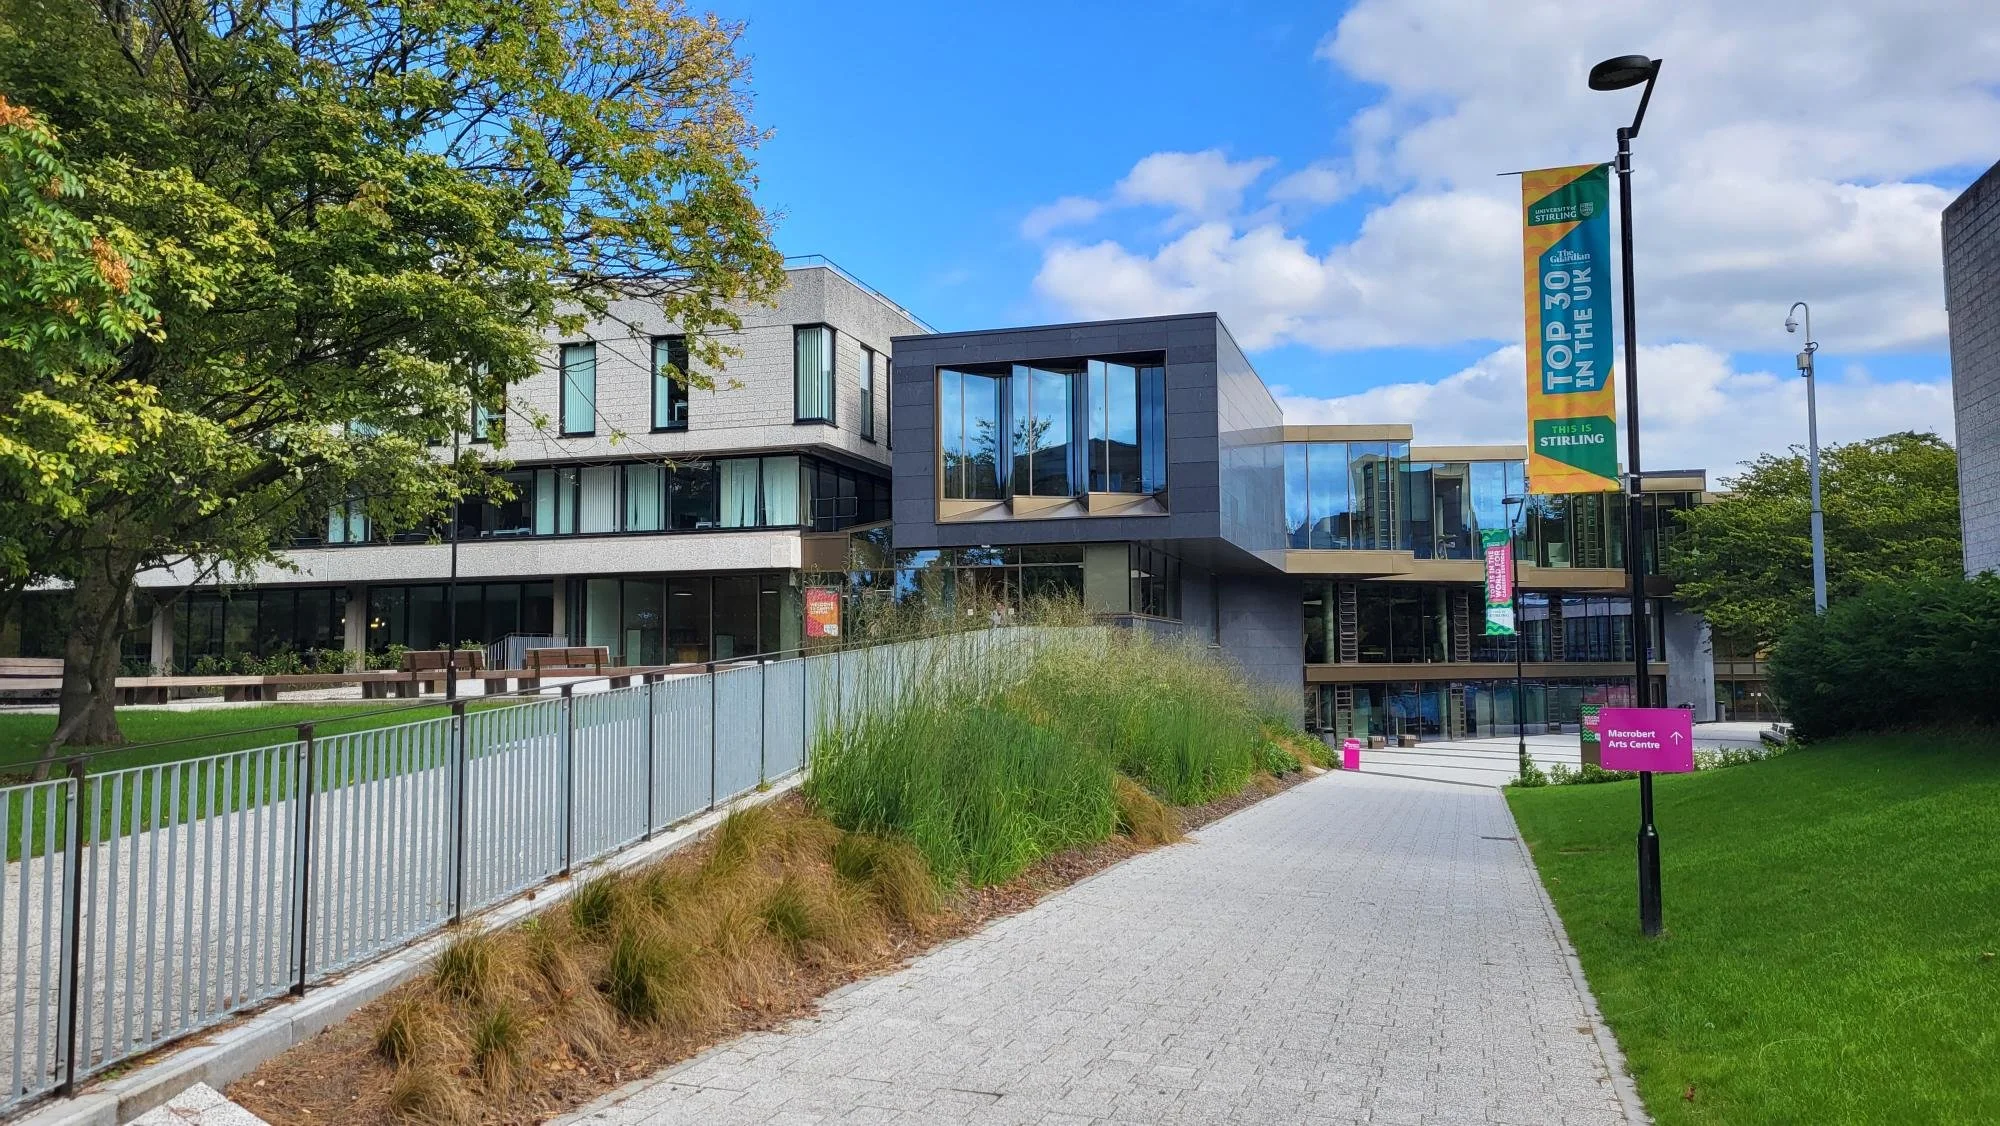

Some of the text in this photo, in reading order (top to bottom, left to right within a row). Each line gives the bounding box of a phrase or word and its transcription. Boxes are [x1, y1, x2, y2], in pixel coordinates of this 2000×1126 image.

[1535, 206, 1570, 214] UNIVERSITY
[1535, 211, 1577, 222] STIRLING
[1549, 252, 1591, 264] Guardian
[1557, 249, 1573, 257] The
[1544, 270, 1573, 390] TOP 30
[1572, 267, 1595, 388] IN THE UK
[1552, 423, 1592, 434] THIS IS
[1540, 433, 1605, 447] STIRLING
[1488, 565, 1495, 574] IN
[1608, 729, 1656, 738] Macrobert
[1608, 740, 1661, 749] Arts Centre
